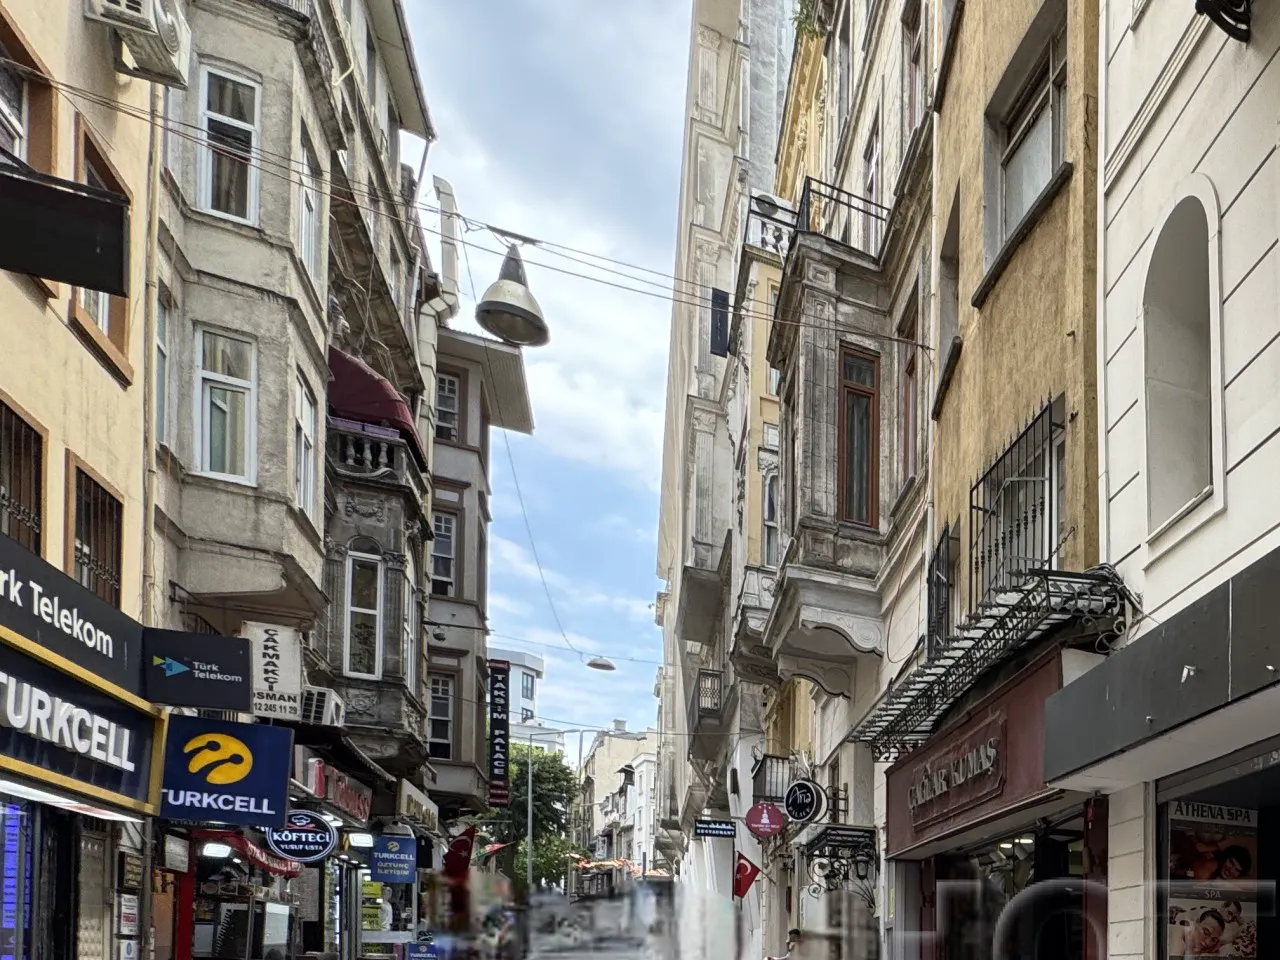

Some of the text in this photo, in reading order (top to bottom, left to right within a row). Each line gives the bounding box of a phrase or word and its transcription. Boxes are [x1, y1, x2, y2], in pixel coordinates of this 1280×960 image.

[29, 580, 113, 658] Telekom
[193, 661, 219, 671] Türk
[193, 670, 242, 682] Telekom
[264, 703, 277, 713] 245
[279, 705, 287, 714] 11
[951, 737, 999, 788] KUMAŞ
[1175, 801, 1252, 823] ATHENA SPA
[373, 852, 415, 860] TURKCELL
[1205, 889, 1222, 899] SPA
